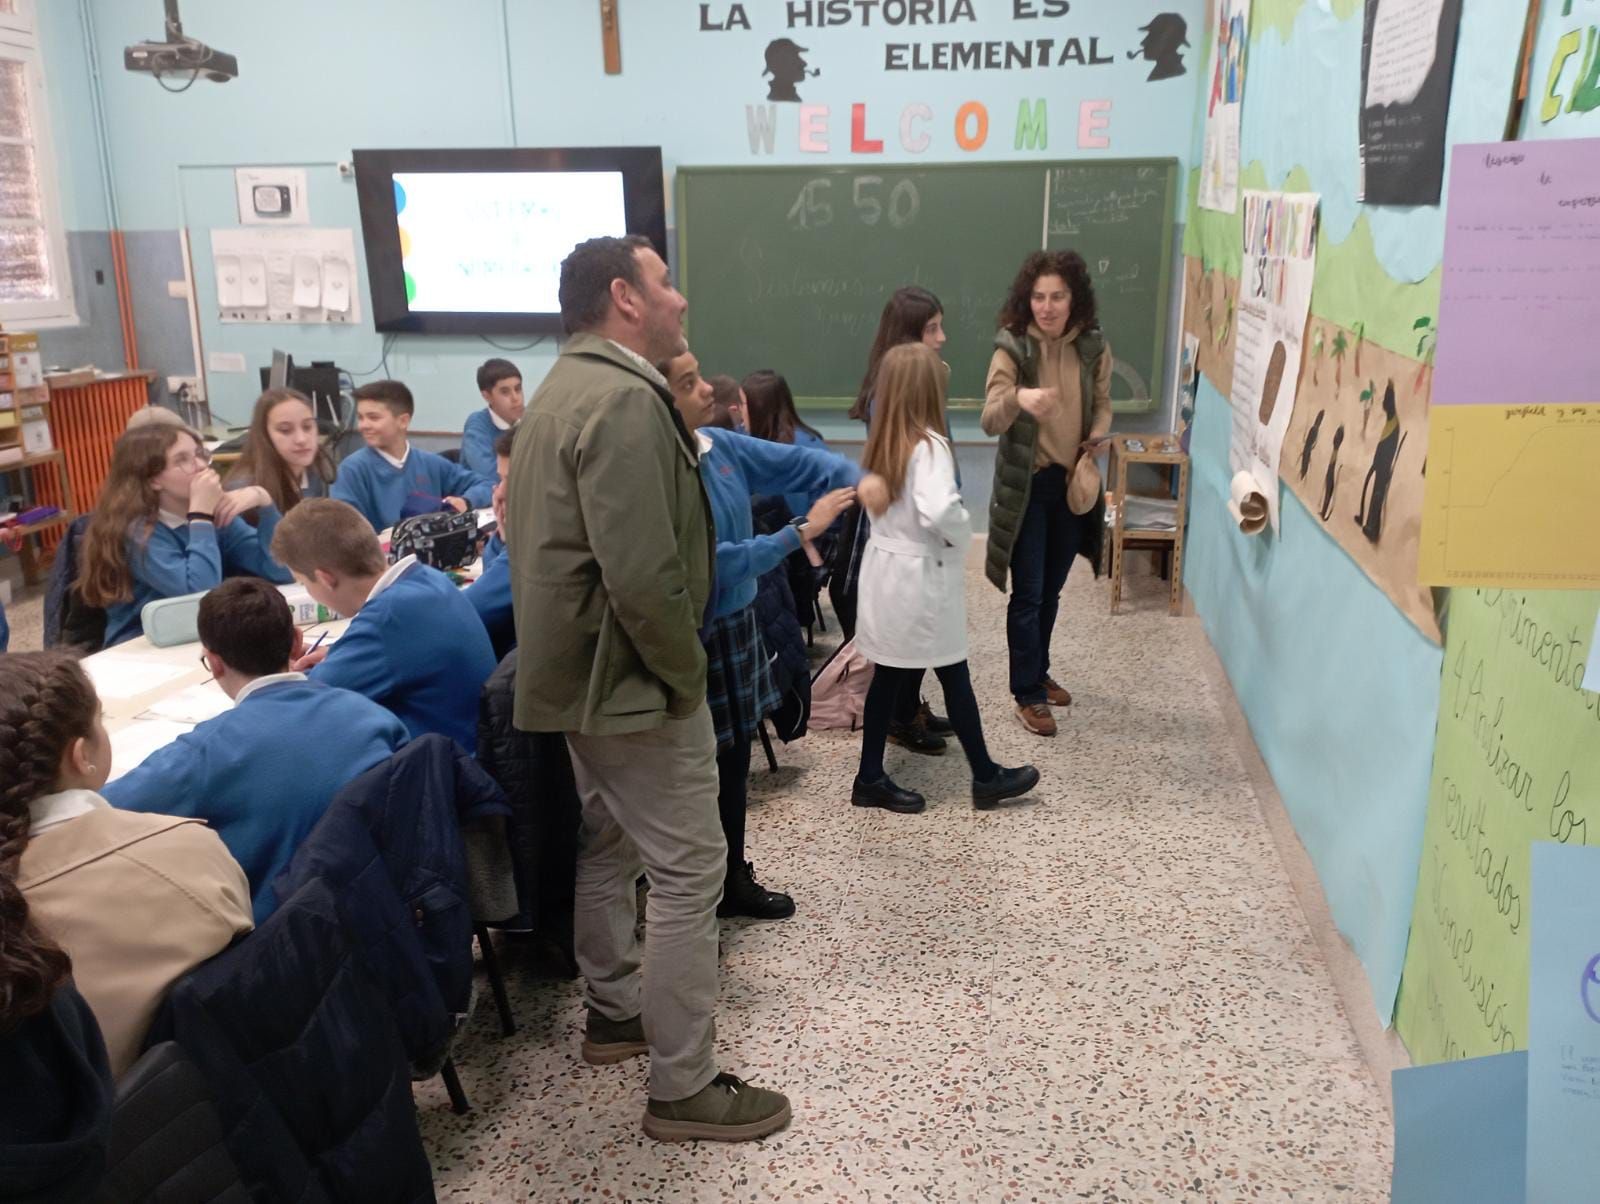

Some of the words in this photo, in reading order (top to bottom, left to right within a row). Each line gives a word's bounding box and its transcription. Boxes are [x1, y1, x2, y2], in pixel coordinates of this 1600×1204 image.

[699, 3, 752, 31] LA
[786, 0, 977, 28] HISTORIA
[1012, 0, 1070, 19] ES
[884, 36, 1114, 71] ELEMENTAL
[745, 98, 1113, 155] WELCOME
